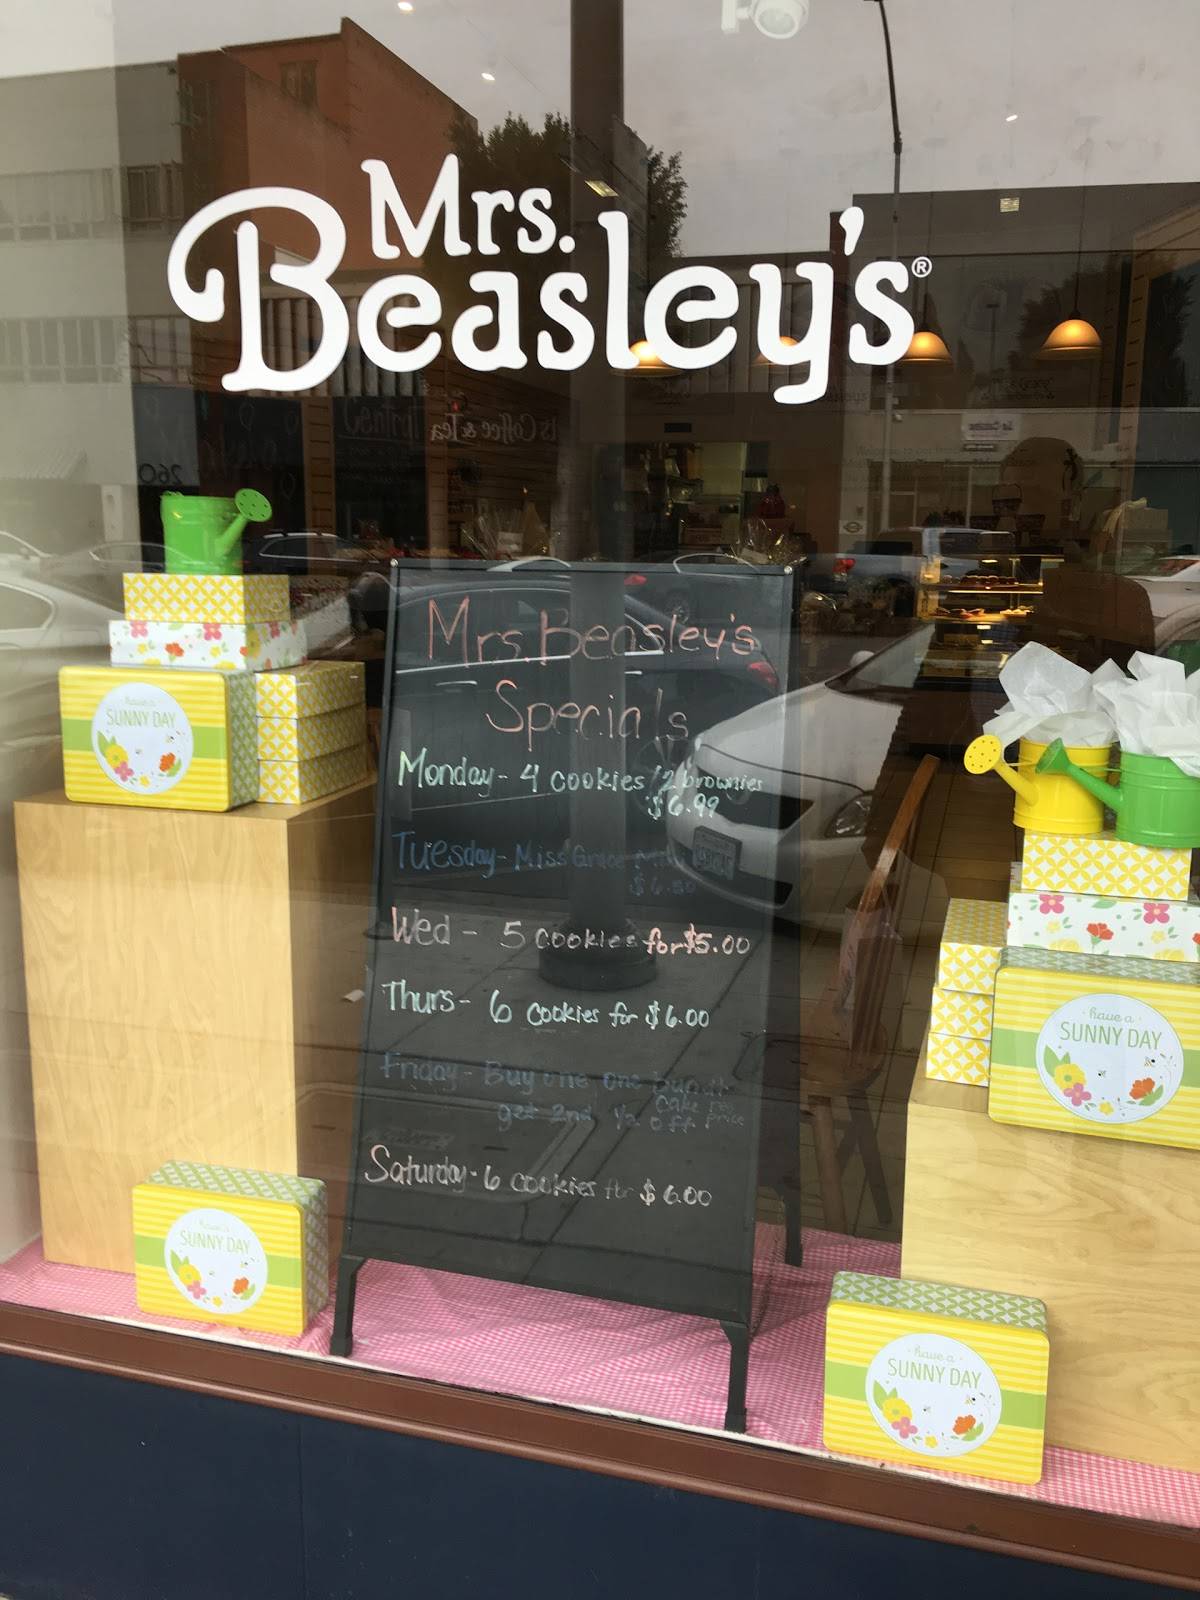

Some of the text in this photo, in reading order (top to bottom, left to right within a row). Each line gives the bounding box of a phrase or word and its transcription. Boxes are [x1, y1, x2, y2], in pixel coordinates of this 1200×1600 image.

[360, 153, 576, 260] Mrs.
[167, 185, 915, 405] Beasley's
[539, 608, 762, 667] Beasley's
[106, 708, 177, 729] SUNNY DAY
[485, 678, 690, 752] Specials
[519, 763, 541, 793] 4
[550, 764, 646, 793] cookies
[390, 904, 452, 947] Wed
[499, 920, 527, 950] 5
[534, 925, 637, 951] cookies
[489, 989, 513, 1024] 6
[608, 1001, 639, 1029] for
[644, 1000, 711, 1031] $6.00
[1089, 1006, 1123, 1023] have
[1059, 1020, 1163, 1051] SUNNY DAY
[483, 1164, 502, 1192] 6
[509, 1171, 598, 1200] cookies
[179, 1230, 251, 1255] SUNNY DAY
[887, 1357, 983, 1391] SUNNY DAY
